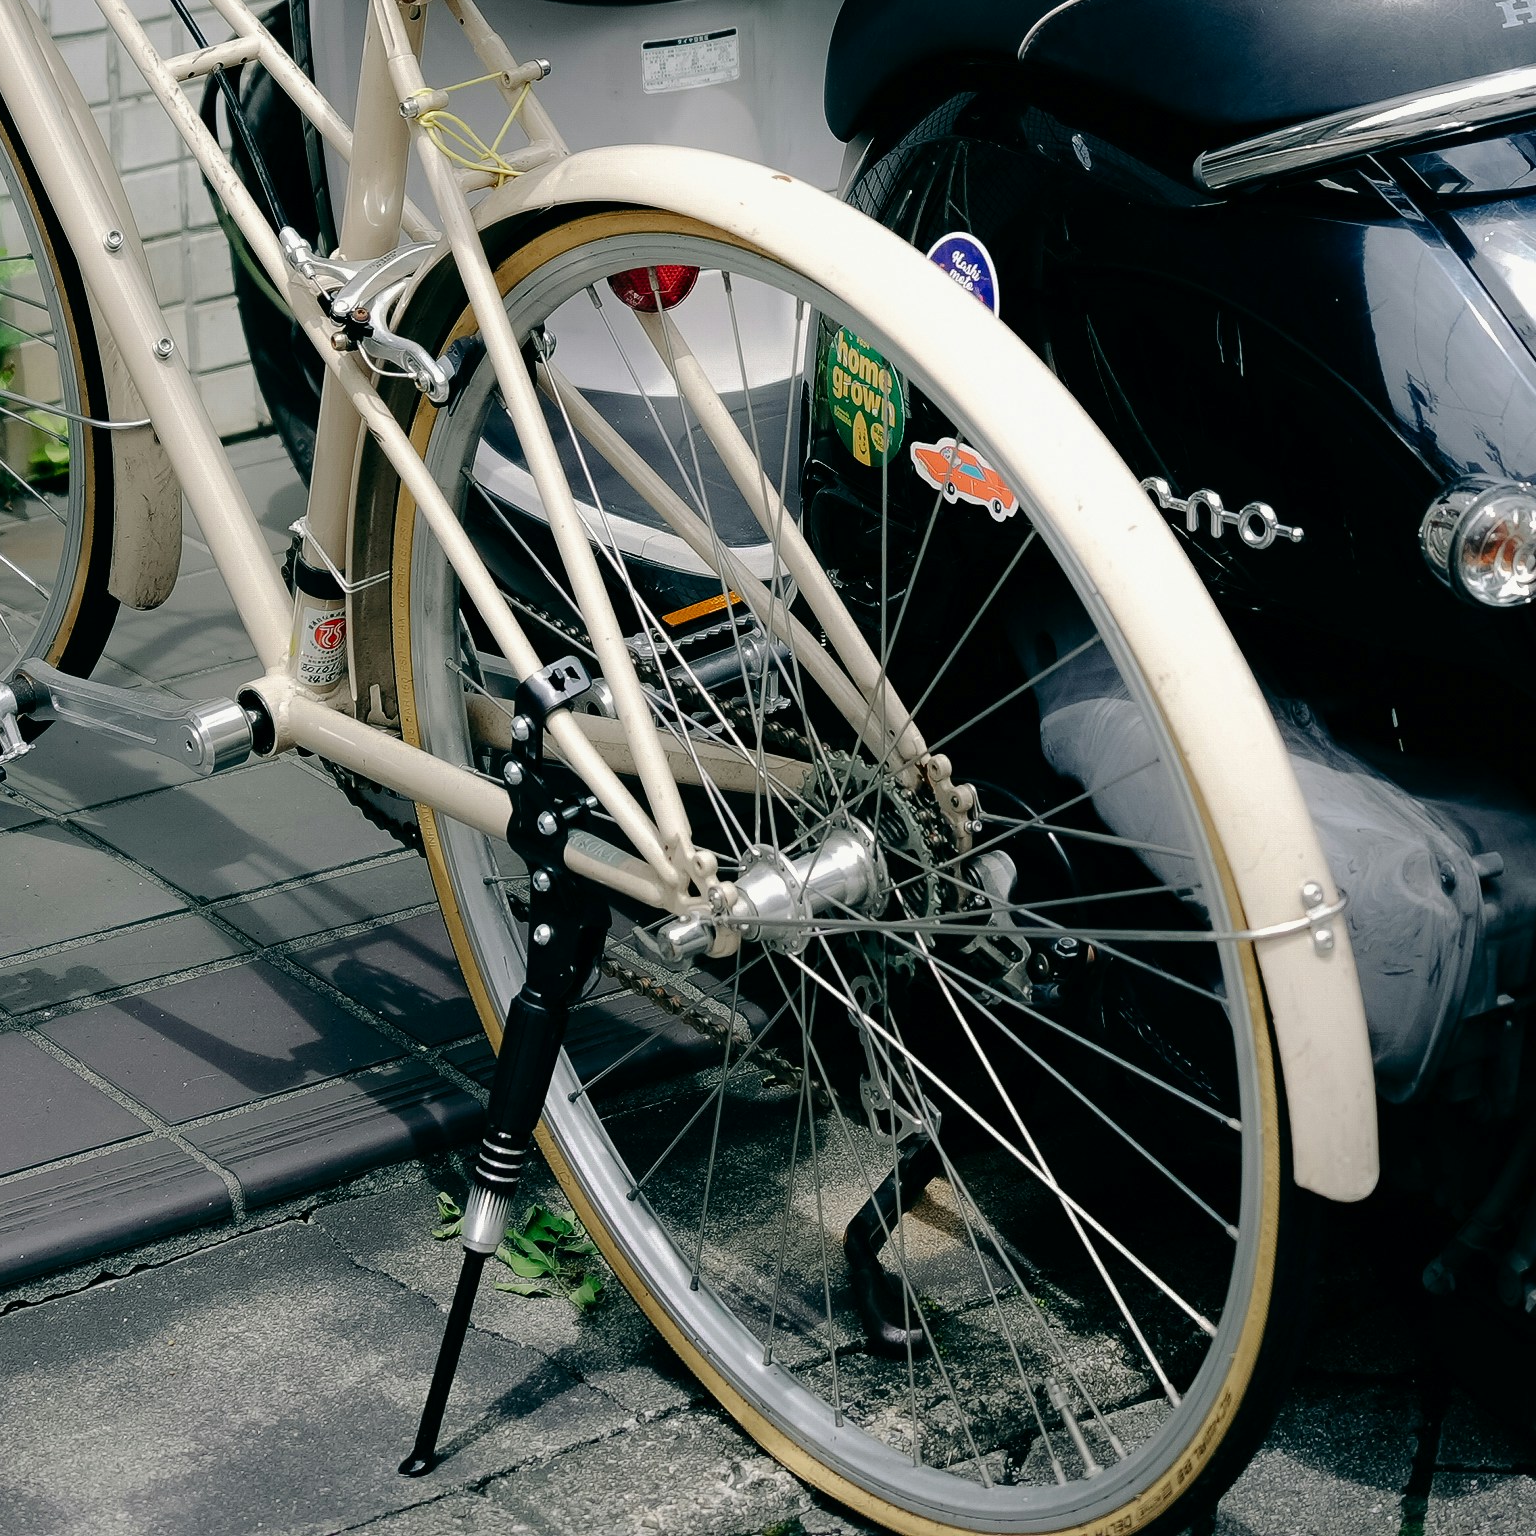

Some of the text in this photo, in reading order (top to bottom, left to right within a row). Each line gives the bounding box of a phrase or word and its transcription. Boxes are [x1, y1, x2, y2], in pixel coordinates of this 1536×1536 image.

[951, 250, 982, 282] Hashi
[837, 330, 893, 396] home
[832, 365, 896, 429] grown
